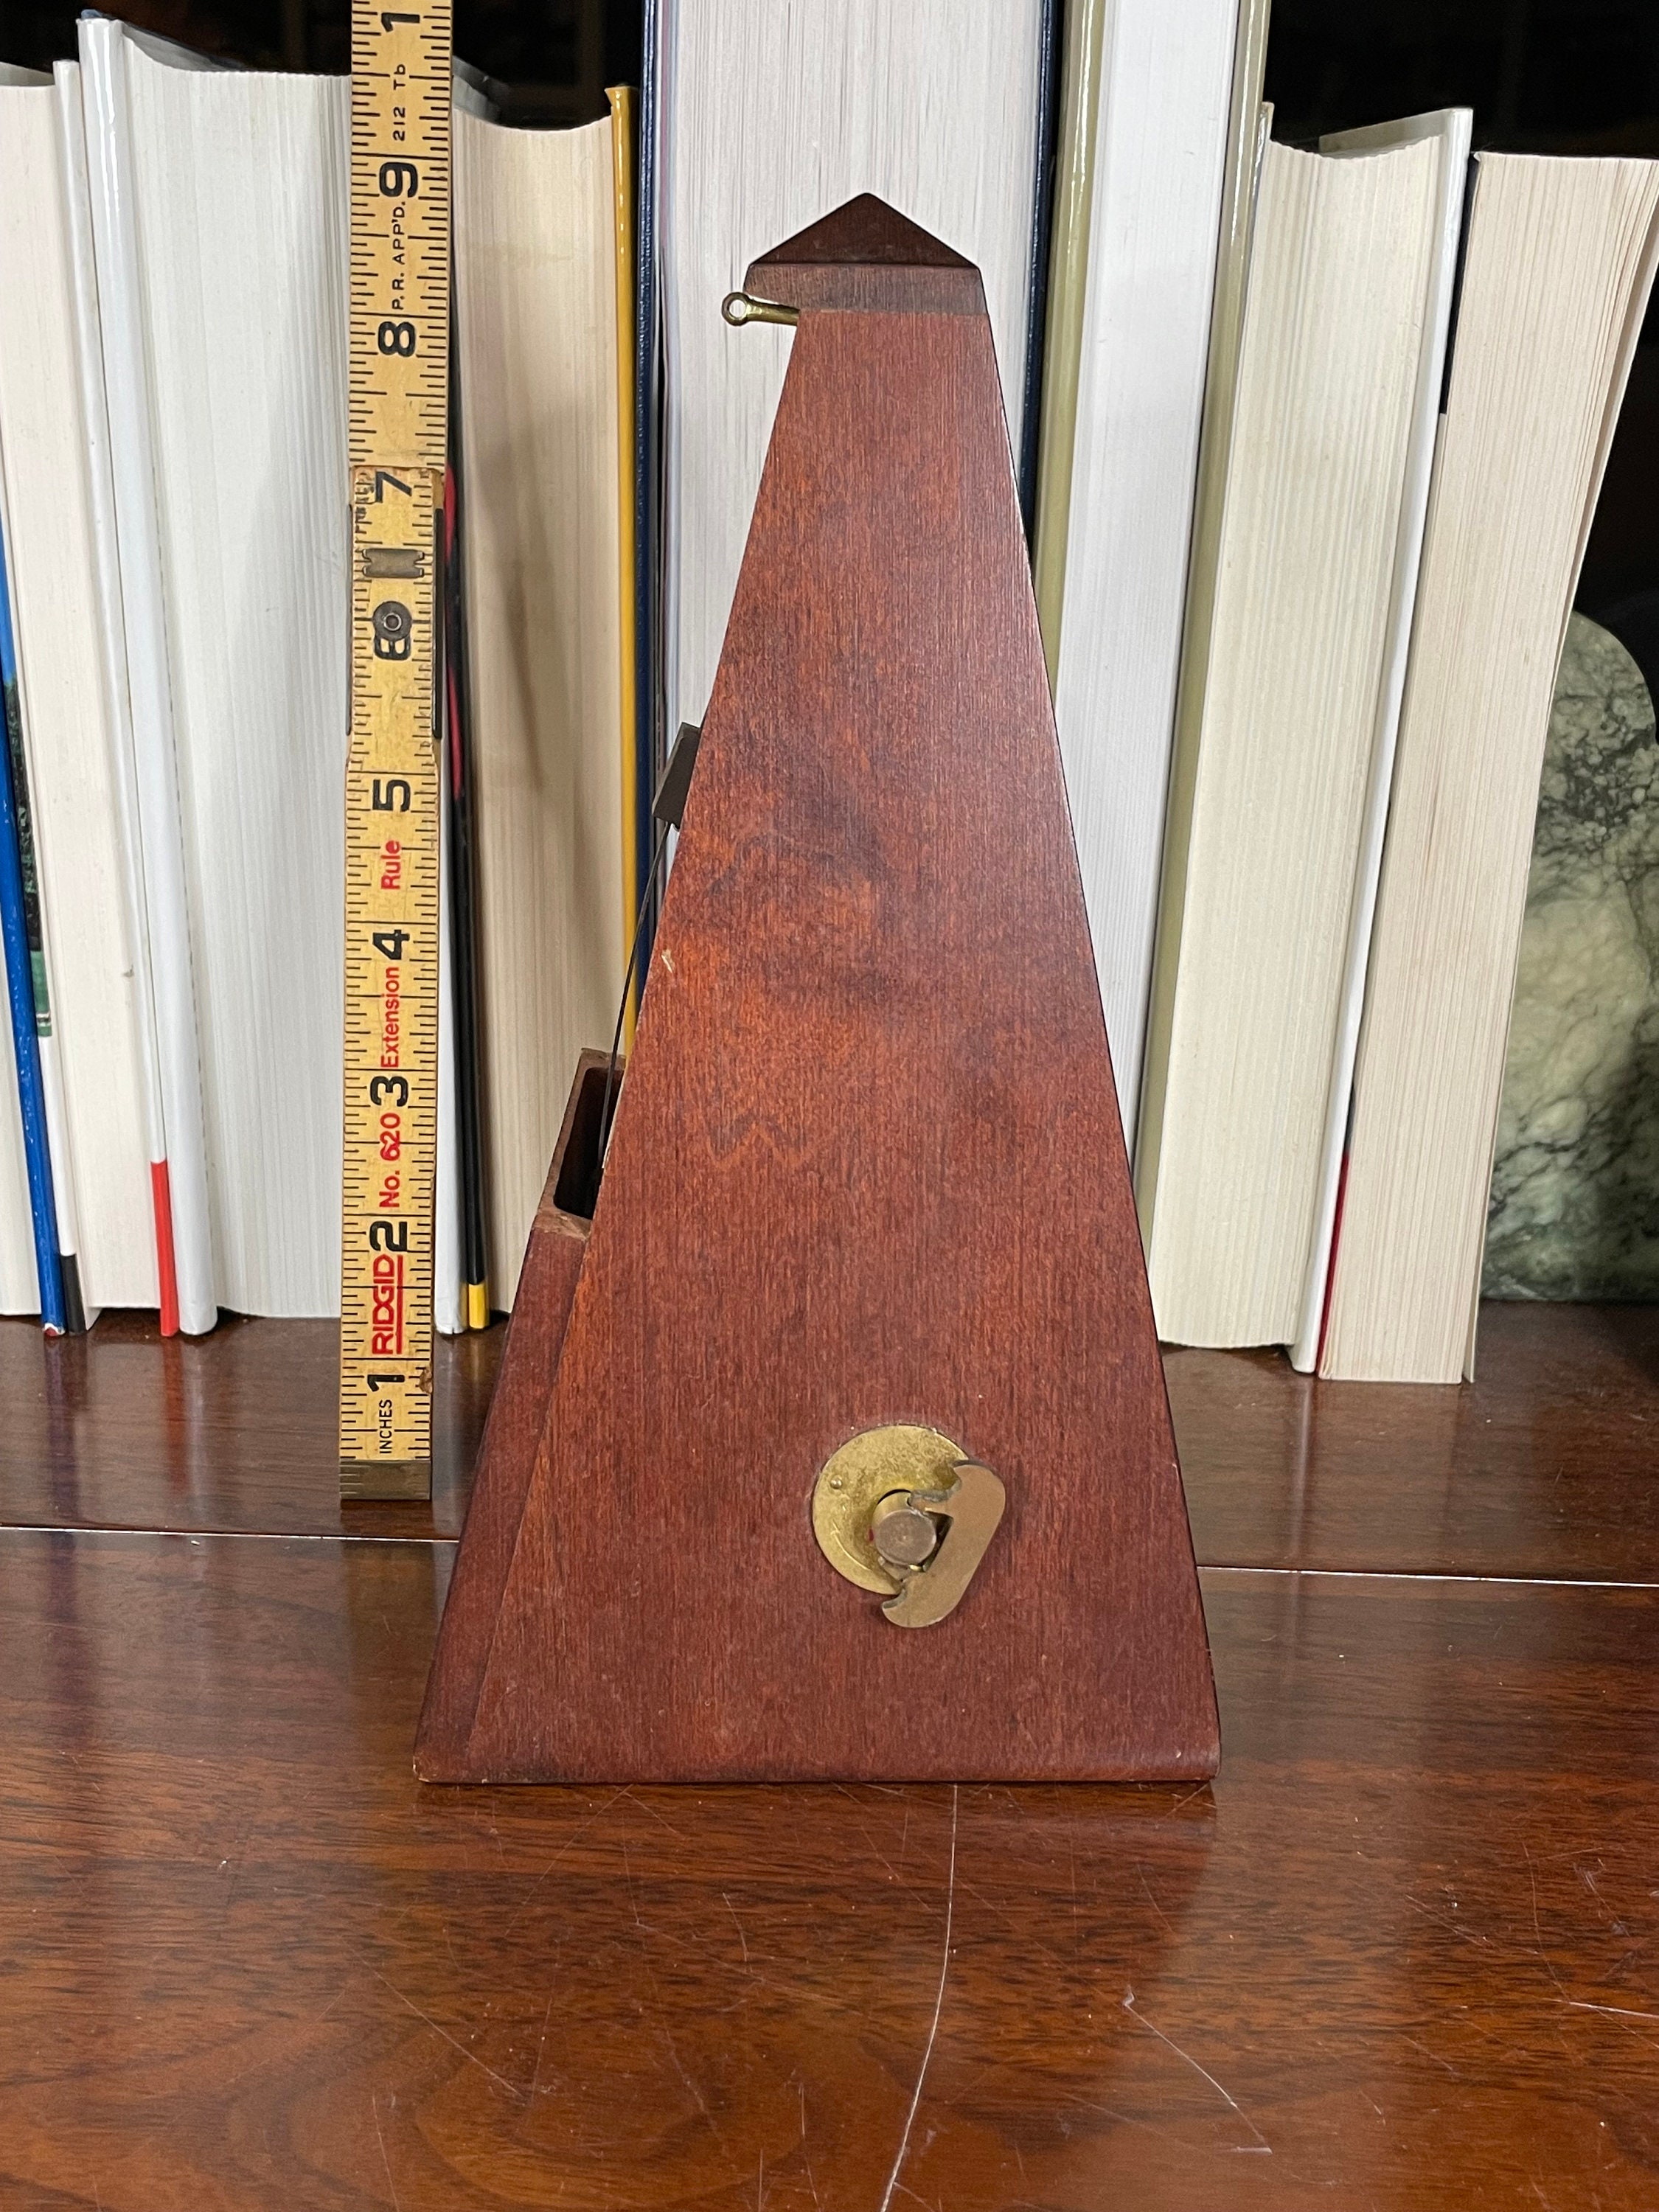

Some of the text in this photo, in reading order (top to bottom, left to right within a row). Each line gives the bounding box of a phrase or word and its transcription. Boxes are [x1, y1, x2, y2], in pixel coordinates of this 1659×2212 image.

[392, 64, 406, 142] 212 Tb
[378, 161, 419, 198] 9
[392, 201, 406, 265] APP'D.
[378, 321, 417, 358] 8
[375, 470, 412, 503] 7
[372, 779, 411, 812] 5
[372, 929, 411, 961] 4
[378, 840, 403, 1208] No. 620 Extension Rule
[369, 1076, 409, 1107] 3
[369, 1220, 408, 1253] 2
[371, 1253, 396, 1355] RIDGID
[366, 1374, 406, 1393] 1
[378, 1399, 393, 1454] INCHES
